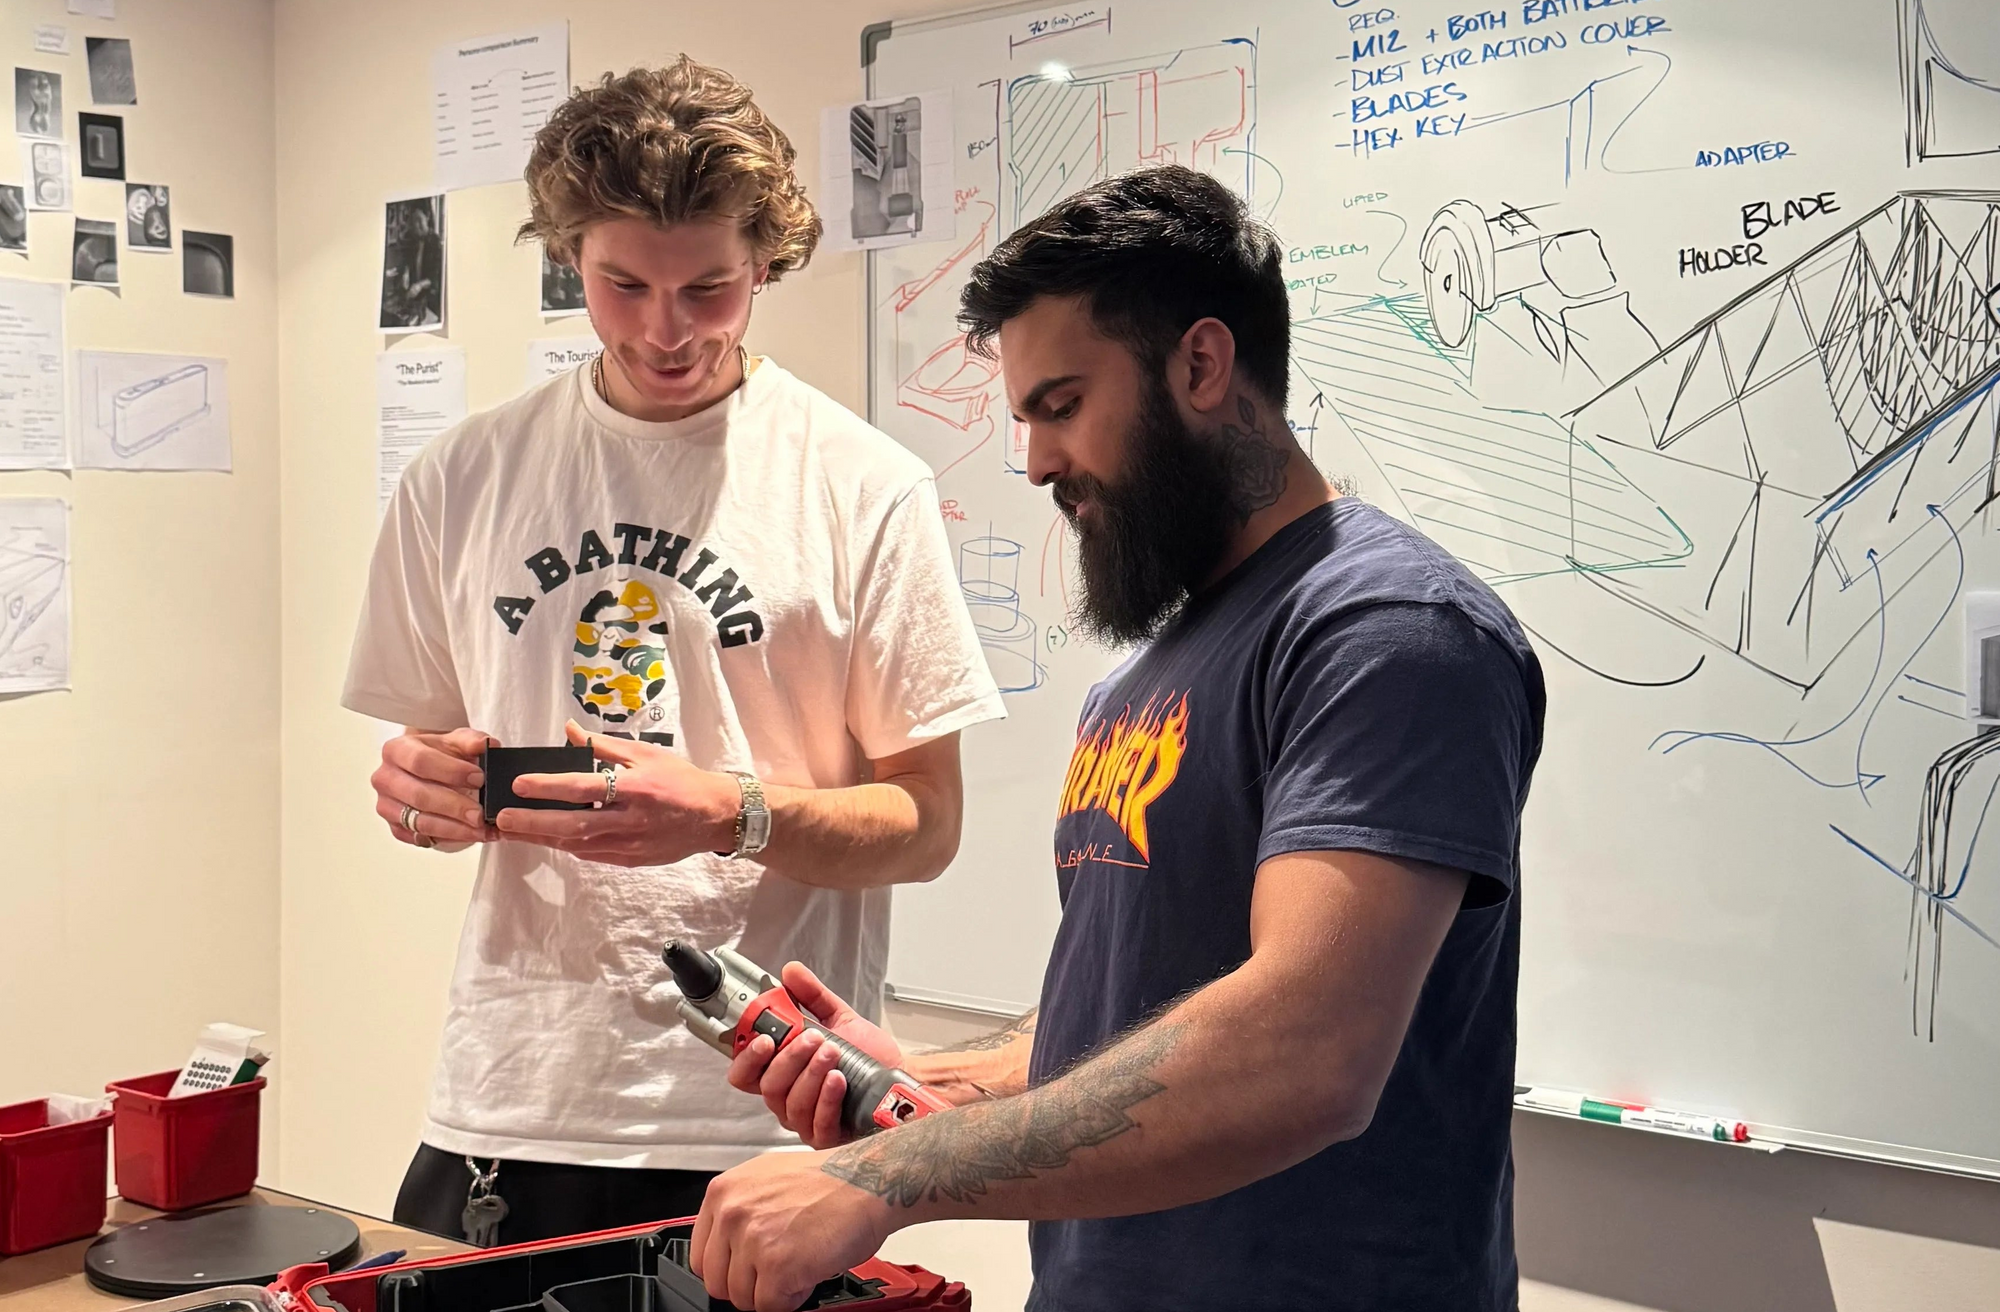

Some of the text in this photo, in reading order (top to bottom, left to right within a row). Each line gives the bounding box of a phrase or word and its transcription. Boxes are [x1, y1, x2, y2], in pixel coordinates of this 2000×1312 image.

[1448, 11, 1507, 41] BOTH
[1421, 31, 1568, 76] EXTRACTION
[1580, 15, 1673, 44] COVER
[1416, 113, 1467, 137] KEY
[1695, 140, 1797, 168] ADAPTER
[1741, 191, 1842, 240] BLADE
[1289, 243, 1370, 264] EMBLEM
[1678, 242, 1769, 279] HOLDER
[493, 522, 765, 649] A BATHING
